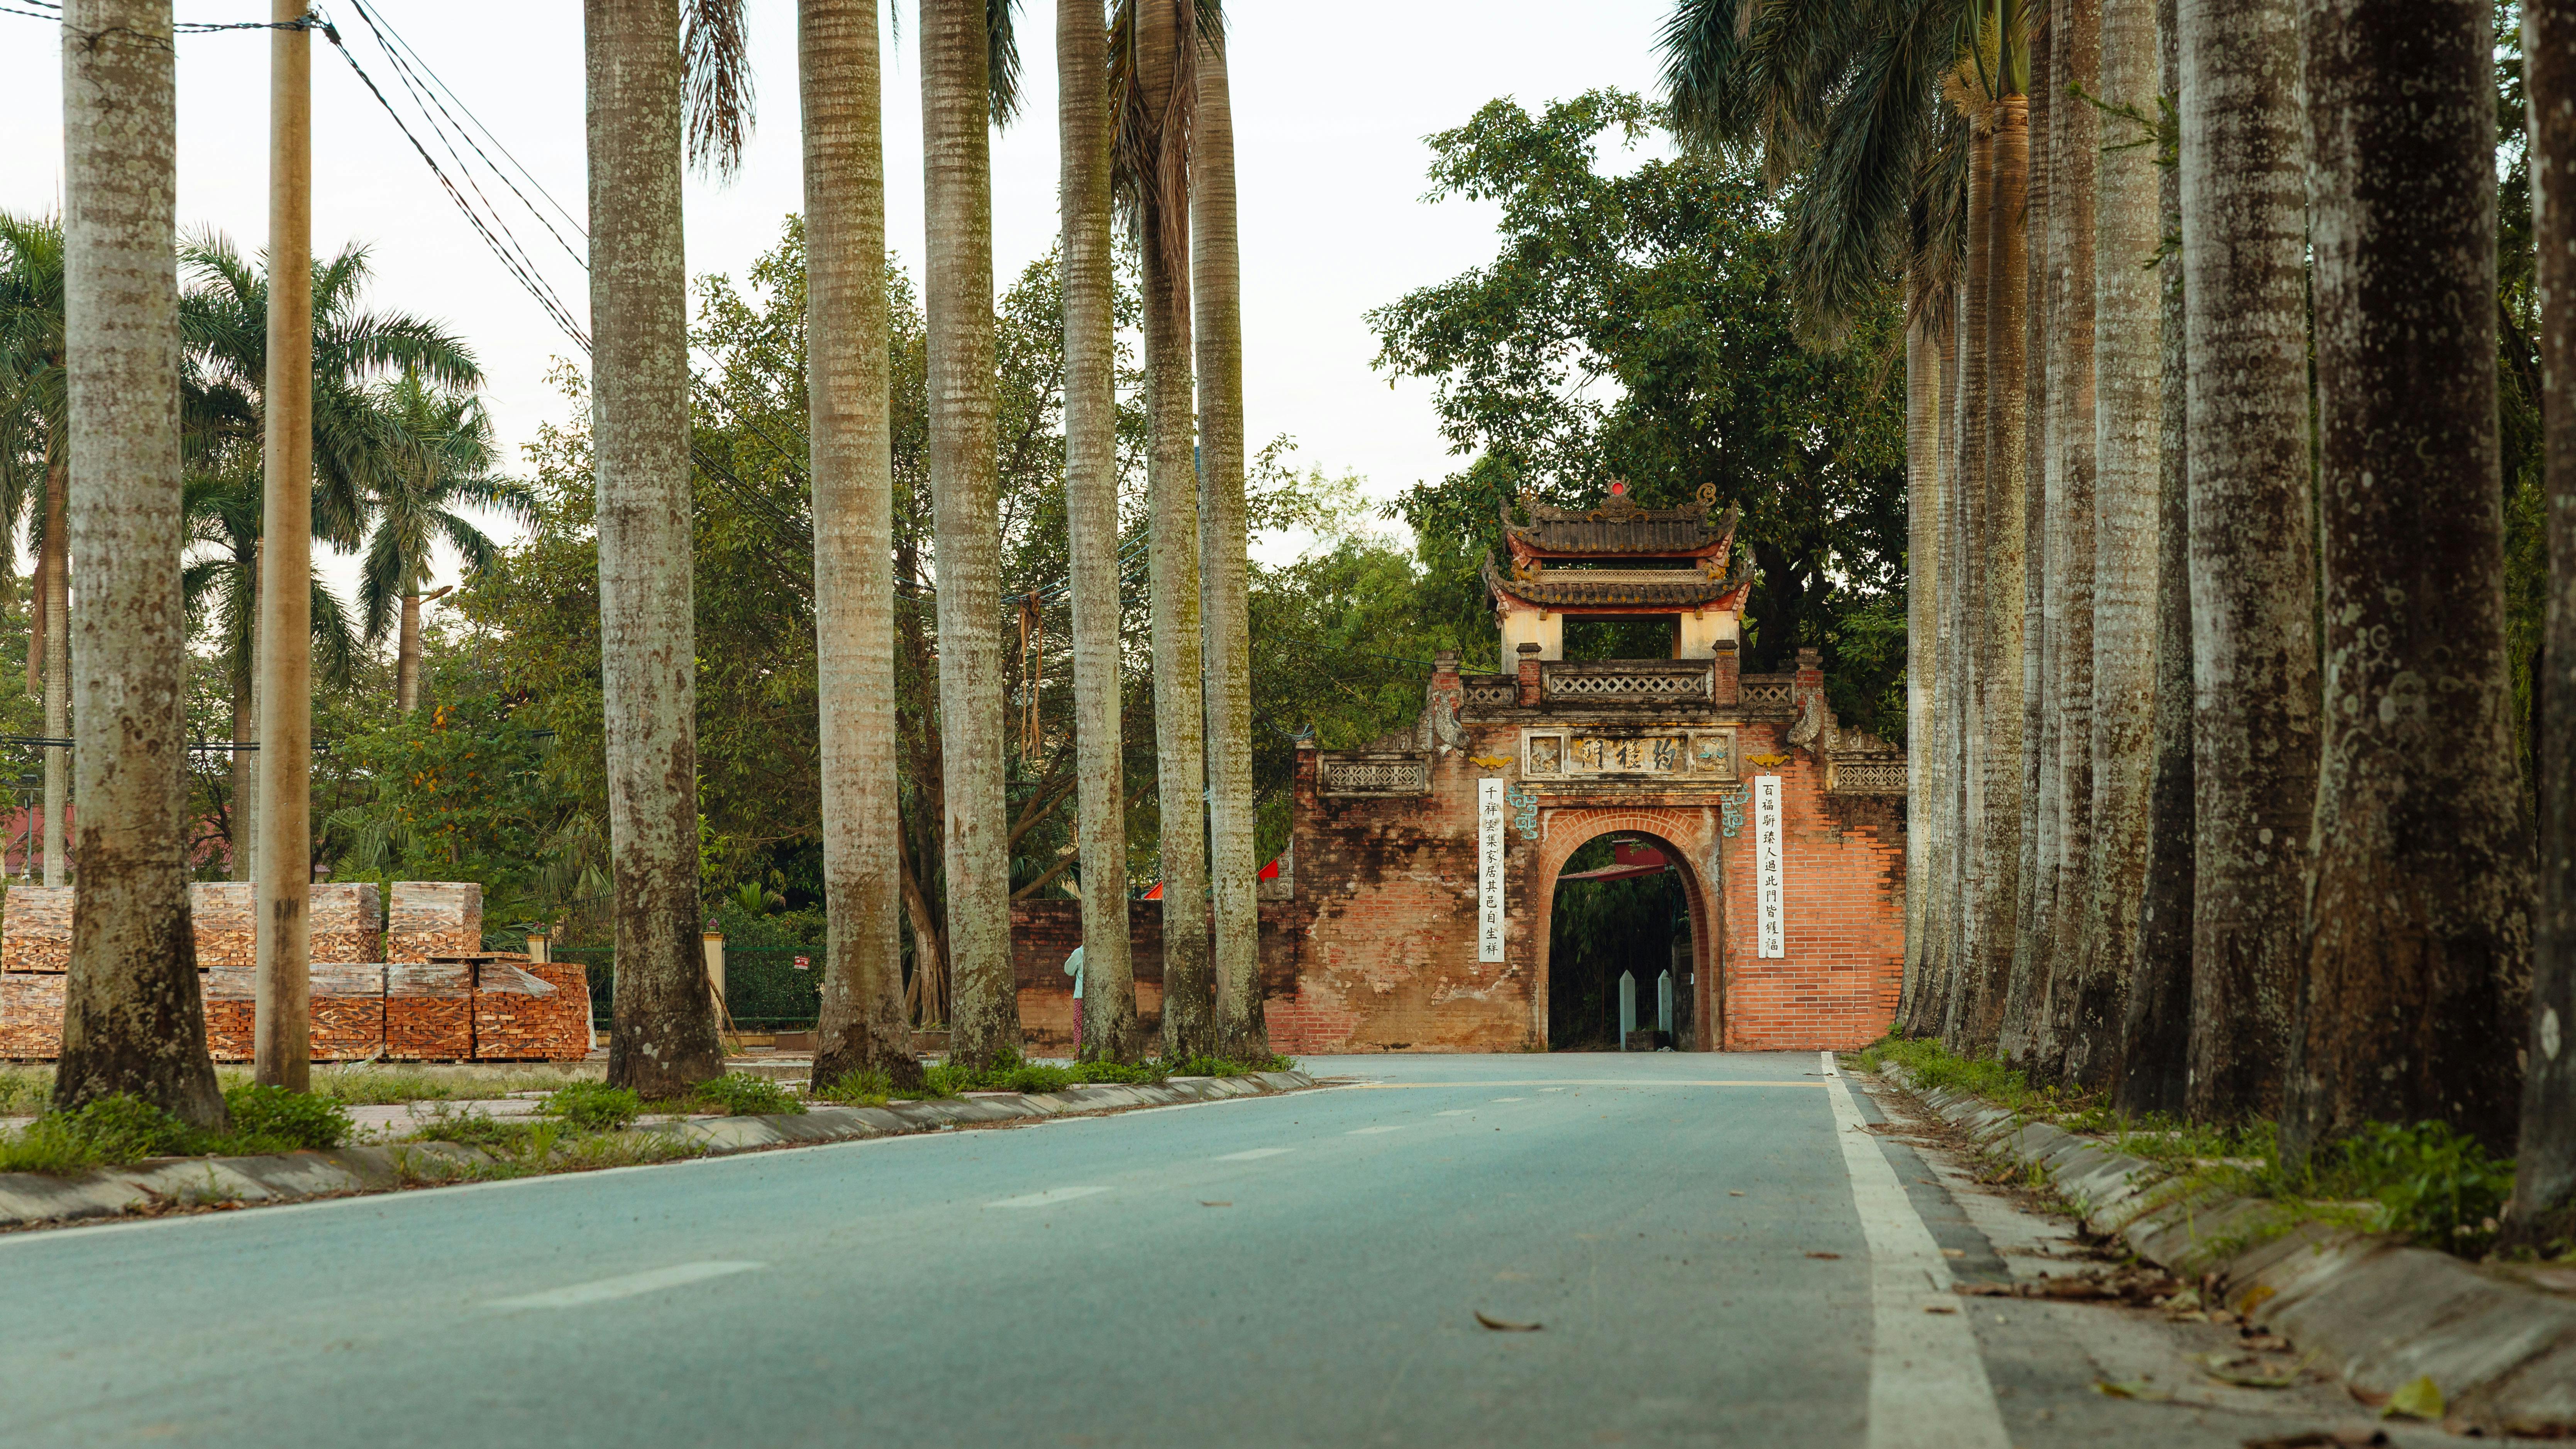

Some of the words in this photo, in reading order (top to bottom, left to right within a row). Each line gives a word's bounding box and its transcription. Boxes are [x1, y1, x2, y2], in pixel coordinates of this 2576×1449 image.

[1485, 786, 1498, 956] 千祥雲集家居其邑自生祥
